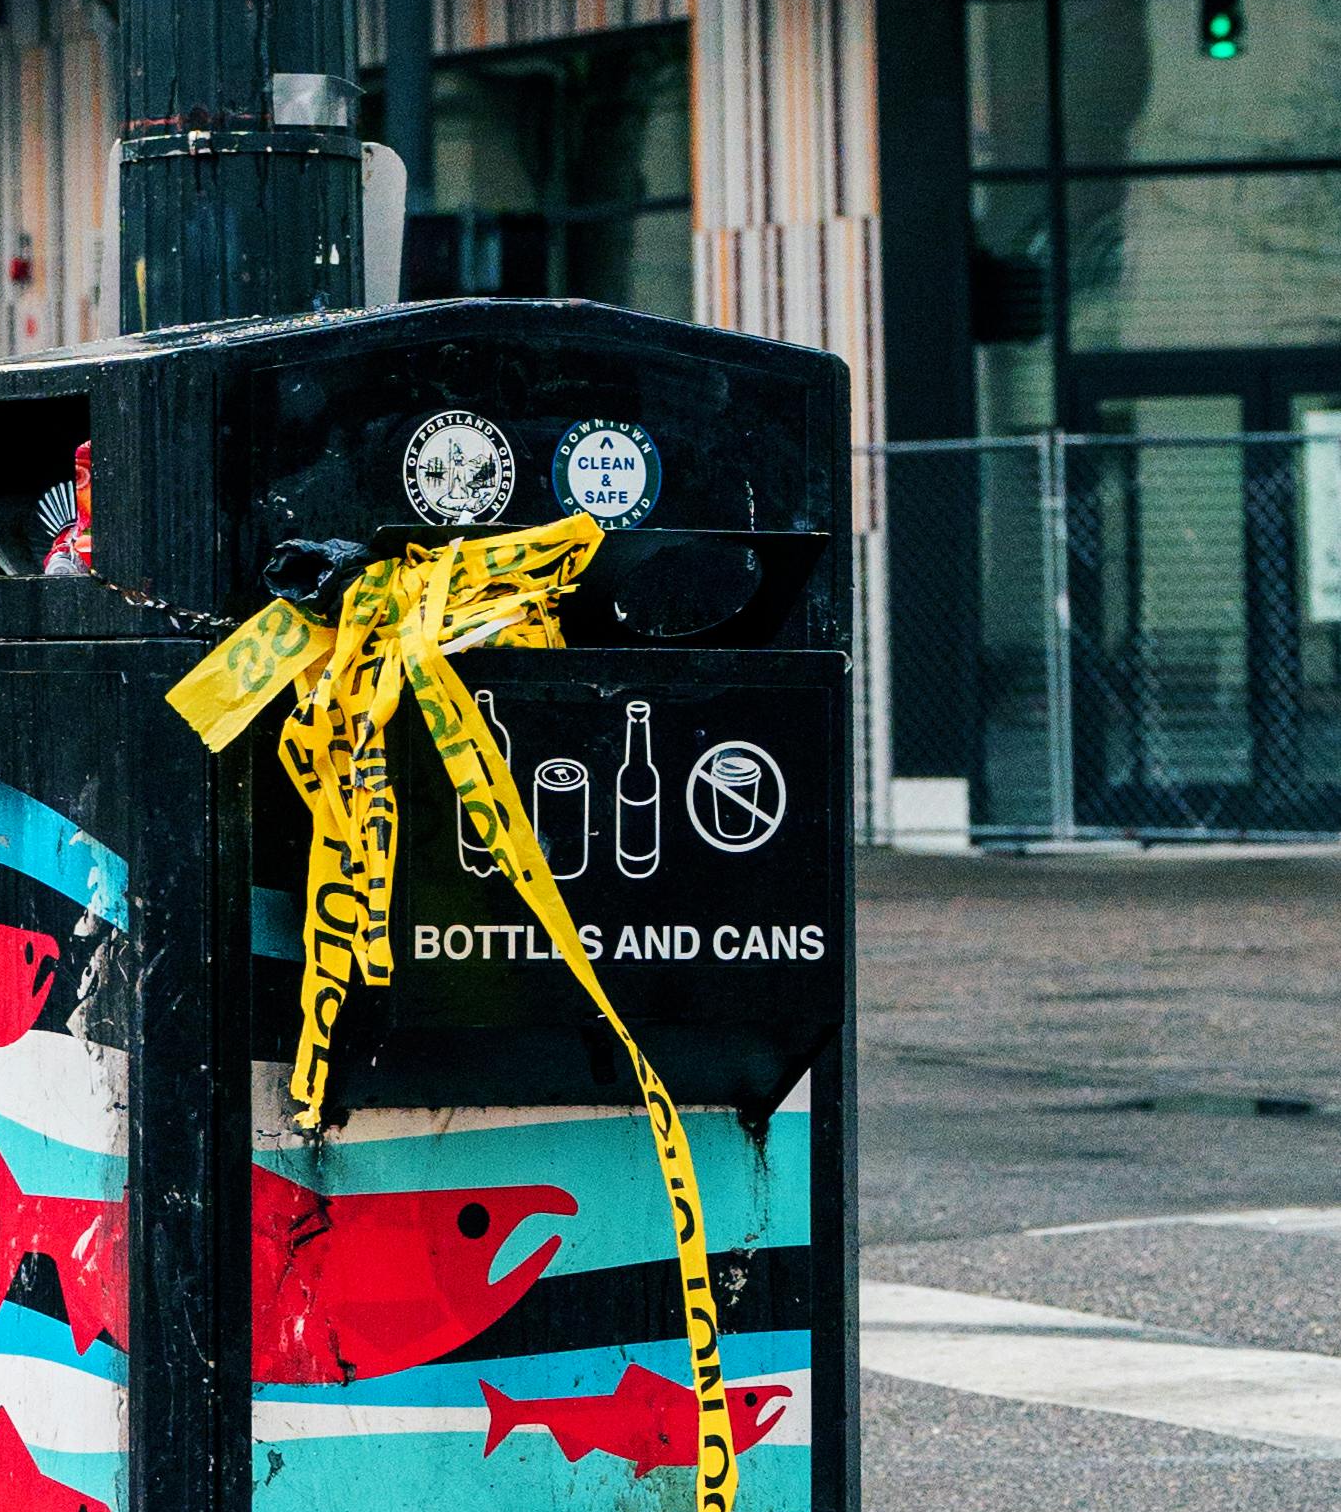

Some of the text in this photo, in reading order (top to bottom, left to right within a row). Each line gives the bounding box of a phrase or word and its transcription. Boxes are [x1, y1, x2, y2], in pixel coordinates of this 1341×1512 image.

[406, 446, 420, 468] OF
[577, 456, 635, 471] CLEAN
[490, 445, 513, 513] OREGON
[601, 473, 613, 488] &
[407, 476, 429, 514] CITY
[584, 490, 629, 505] SAFE
[563, 496, 651, 531] POTLAND
[414, 924, 826, 961] BOTTLS AND CANS
